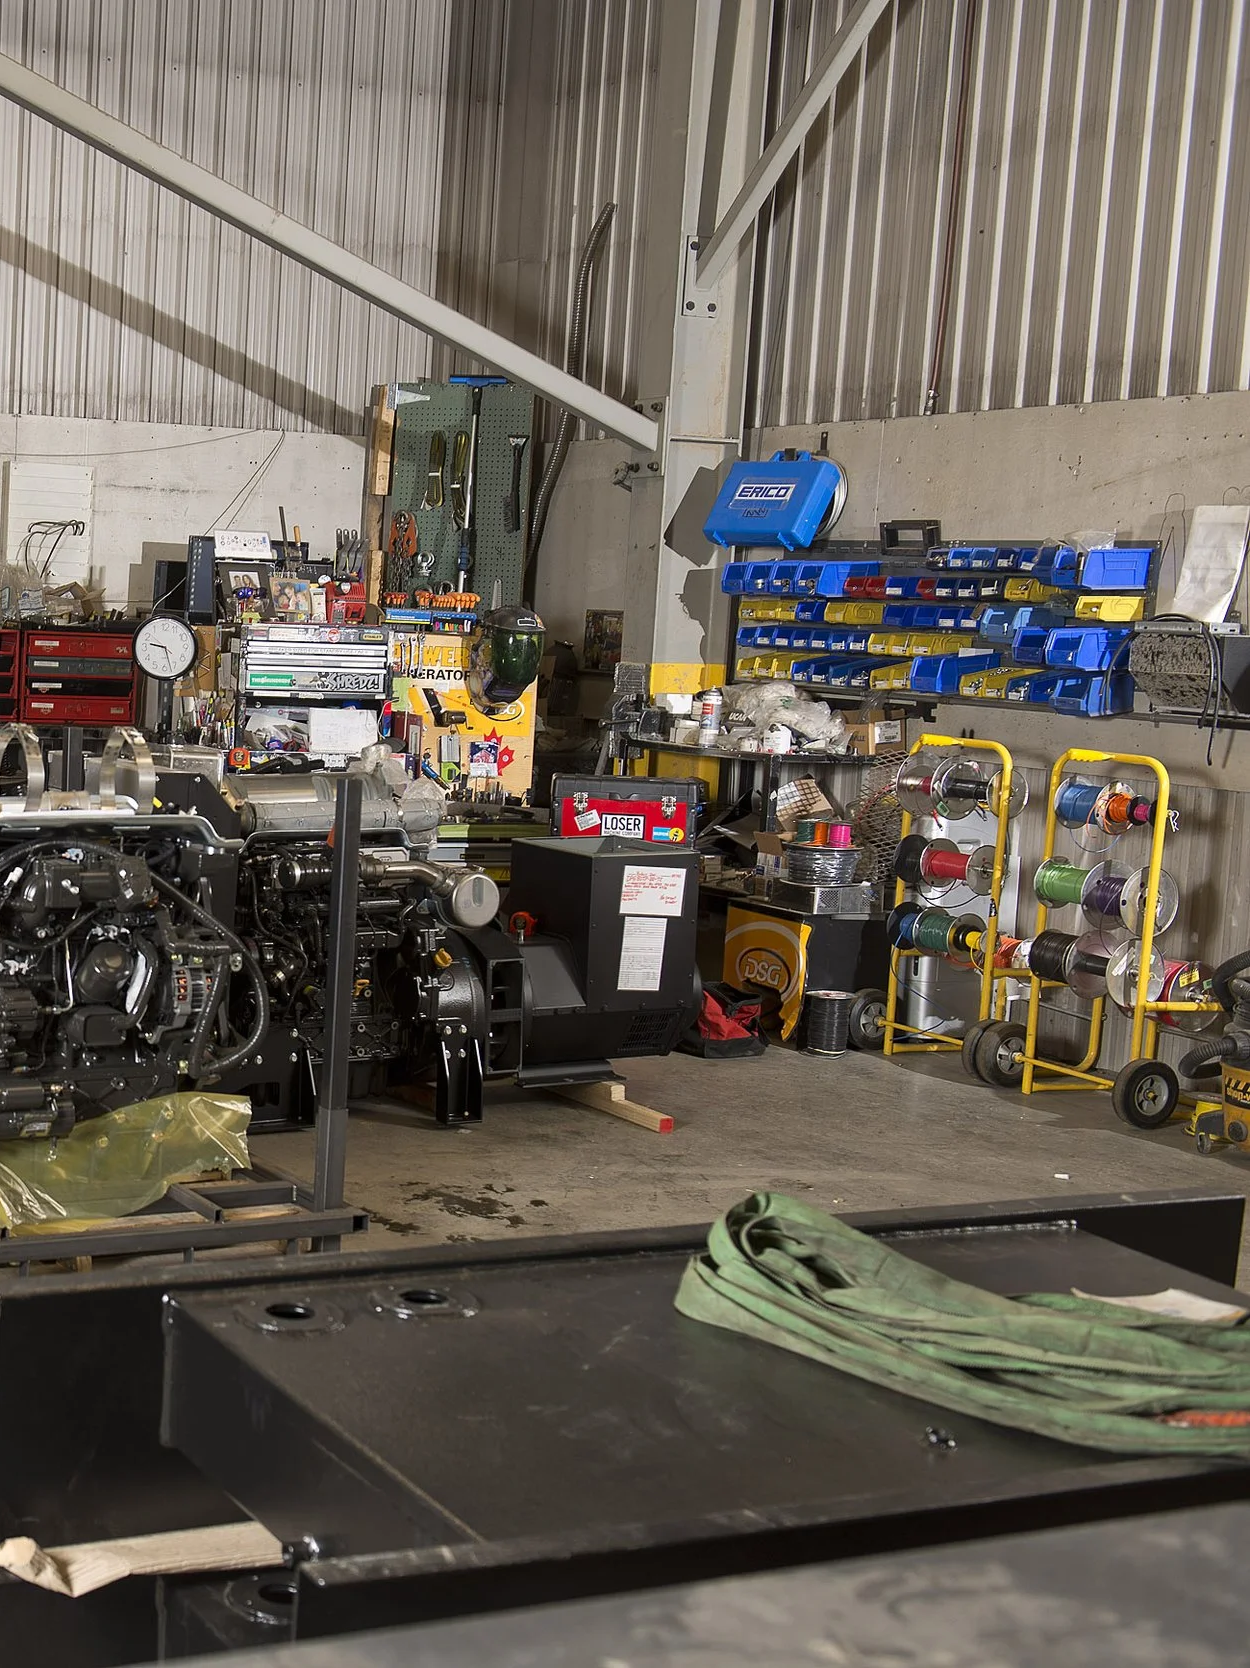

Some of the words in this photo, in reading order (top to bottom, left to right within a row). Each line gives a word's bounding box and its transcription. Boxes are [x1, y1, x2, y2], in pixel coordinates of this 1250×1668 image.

[738, 485, 791, 498] ERICO
[161, 622, 170, 632] 12
[172, 625, 178, 633] 11
[144, 632, 150, 641] 2
[179, 633, 187, 642] 10
[141, 643, 148, 652] 3
[182, 643, 189, 652] 9
[179, 654, 186, 662] 8
[152, 661, 158, 670] 5
[162, 664, 168, 672] 6
[604, 815, 641, 832] LOSER
[744, 956, 782, 986] DSG
